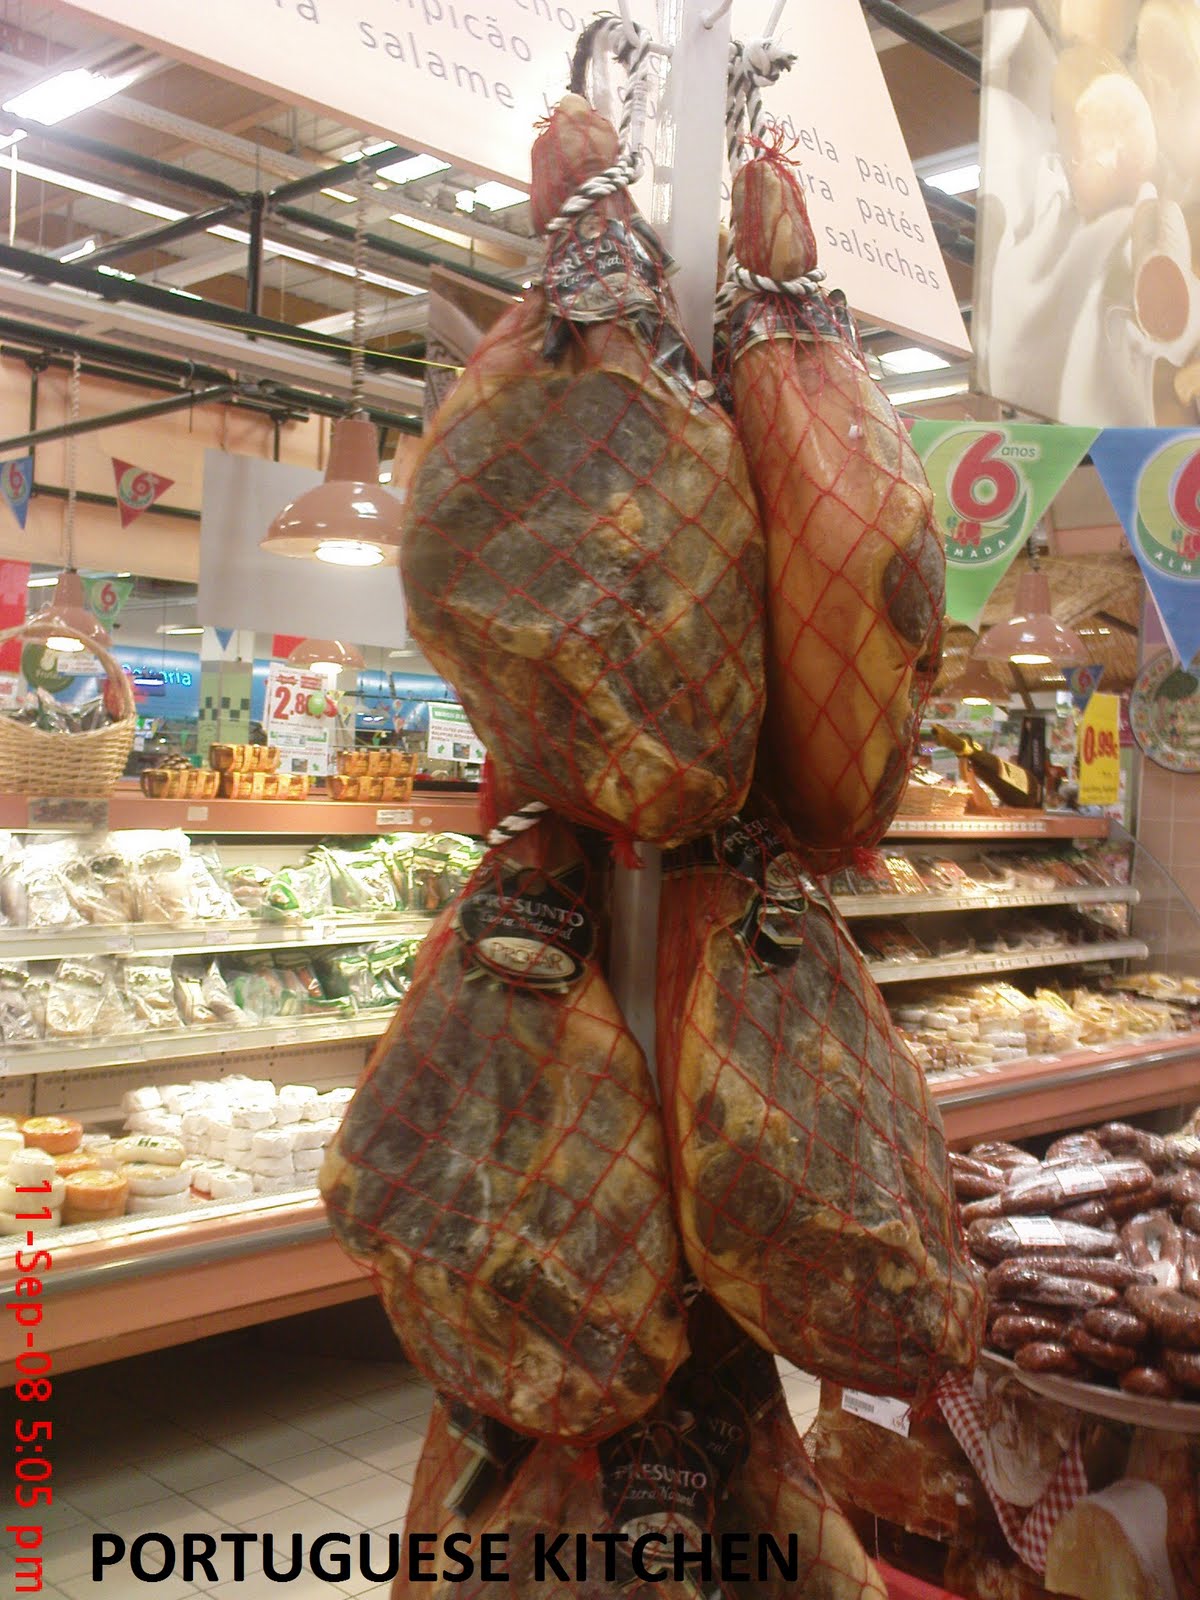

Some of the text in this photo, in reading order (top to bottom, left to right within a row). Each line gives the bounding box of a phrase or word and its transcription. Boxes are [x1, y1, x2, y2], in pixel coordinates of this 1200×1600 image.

[394, 0, 533, 62] picão
[357, 19, 516, 110] salame
[855, 155, 910, 197] paio
[855, 196, 926, 243] patés
[825, 225, 940, 290] salsichas
[951, 431, 1036, 522] 6 anos
[944, 539, 1006, 558] MADA
[472, 893, 585, 928] PRESUNTO
